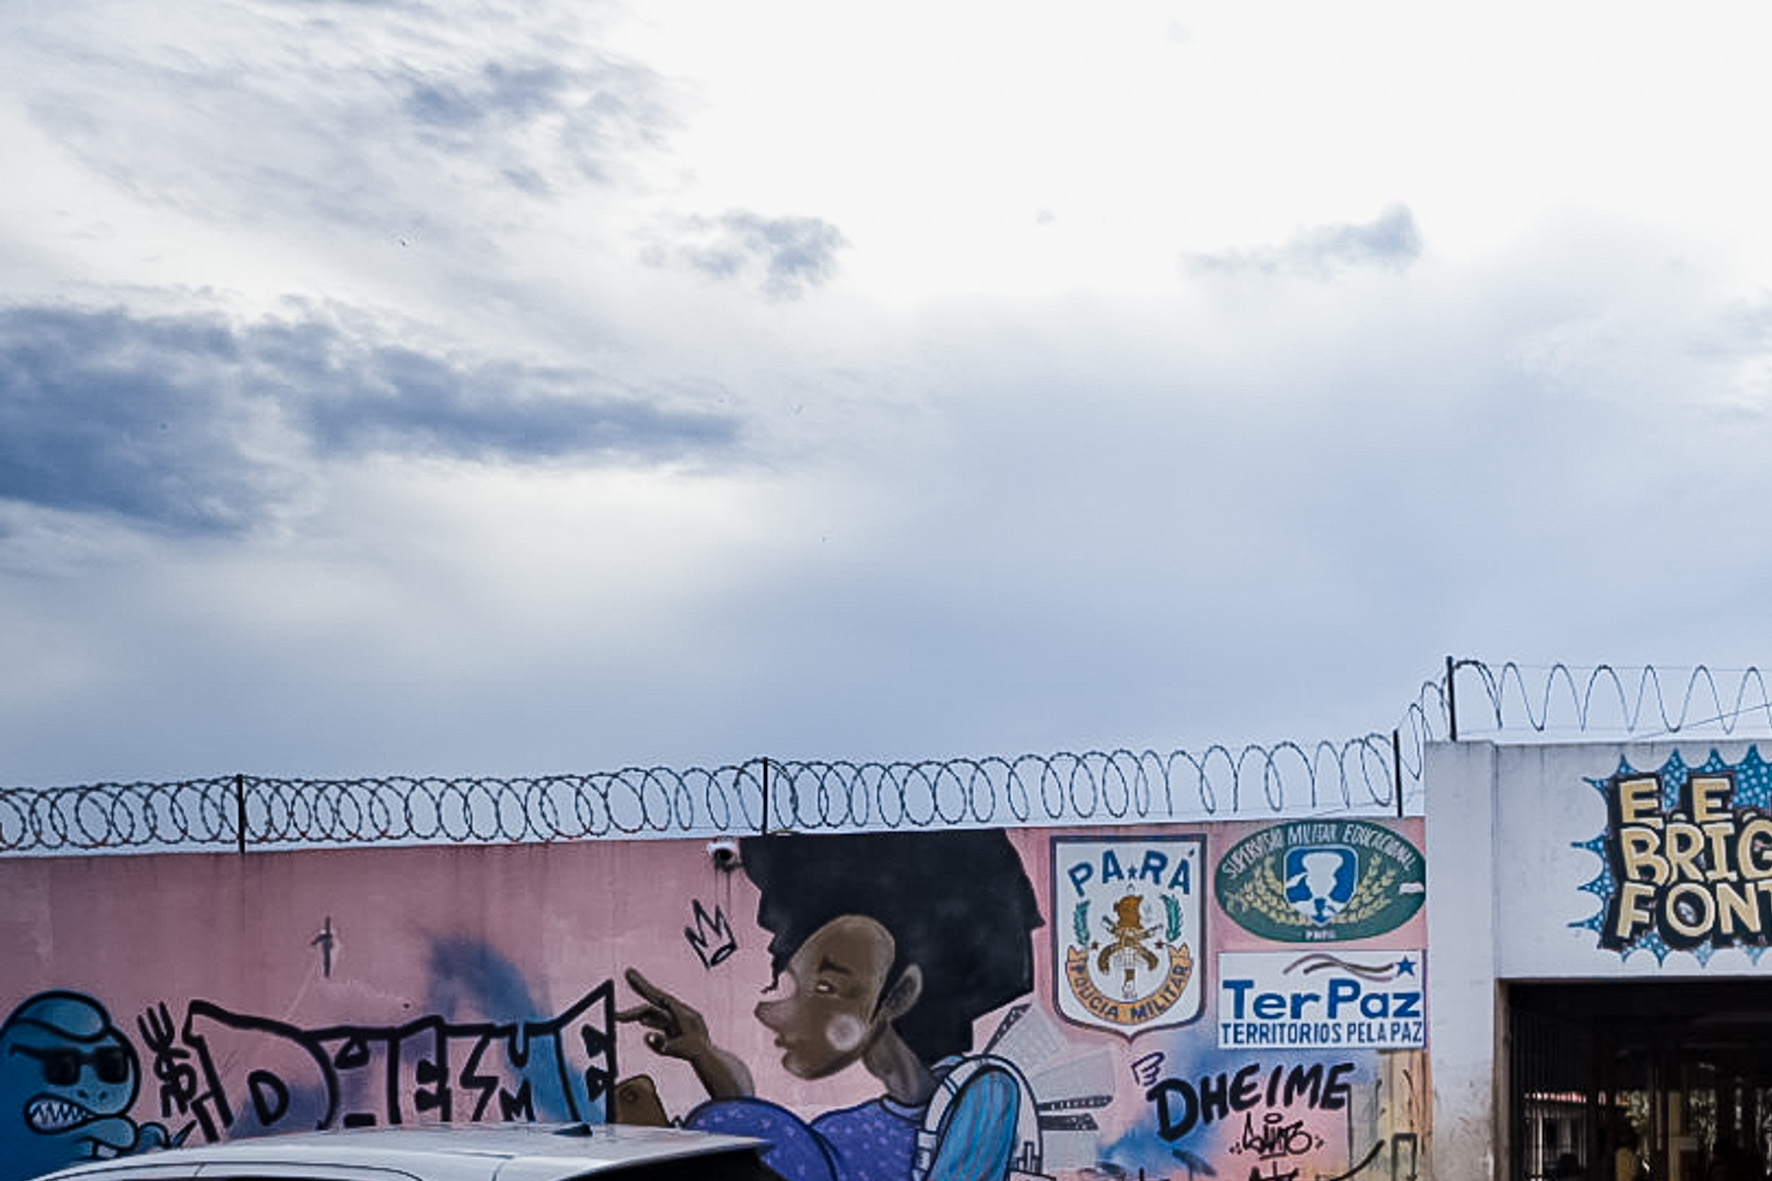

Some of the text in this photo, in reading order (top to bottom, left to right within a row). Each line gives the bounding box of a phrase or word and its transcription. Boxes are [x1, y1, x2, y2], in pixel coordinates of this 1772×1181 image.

[1067, 847, 1196, 898] PARÁ
[1346, 1022, 1387, 1044] PELA
[1390, 1021, 1423, 1043] PAZ
[1146, 1062, 1355, 1143] DHEIME
